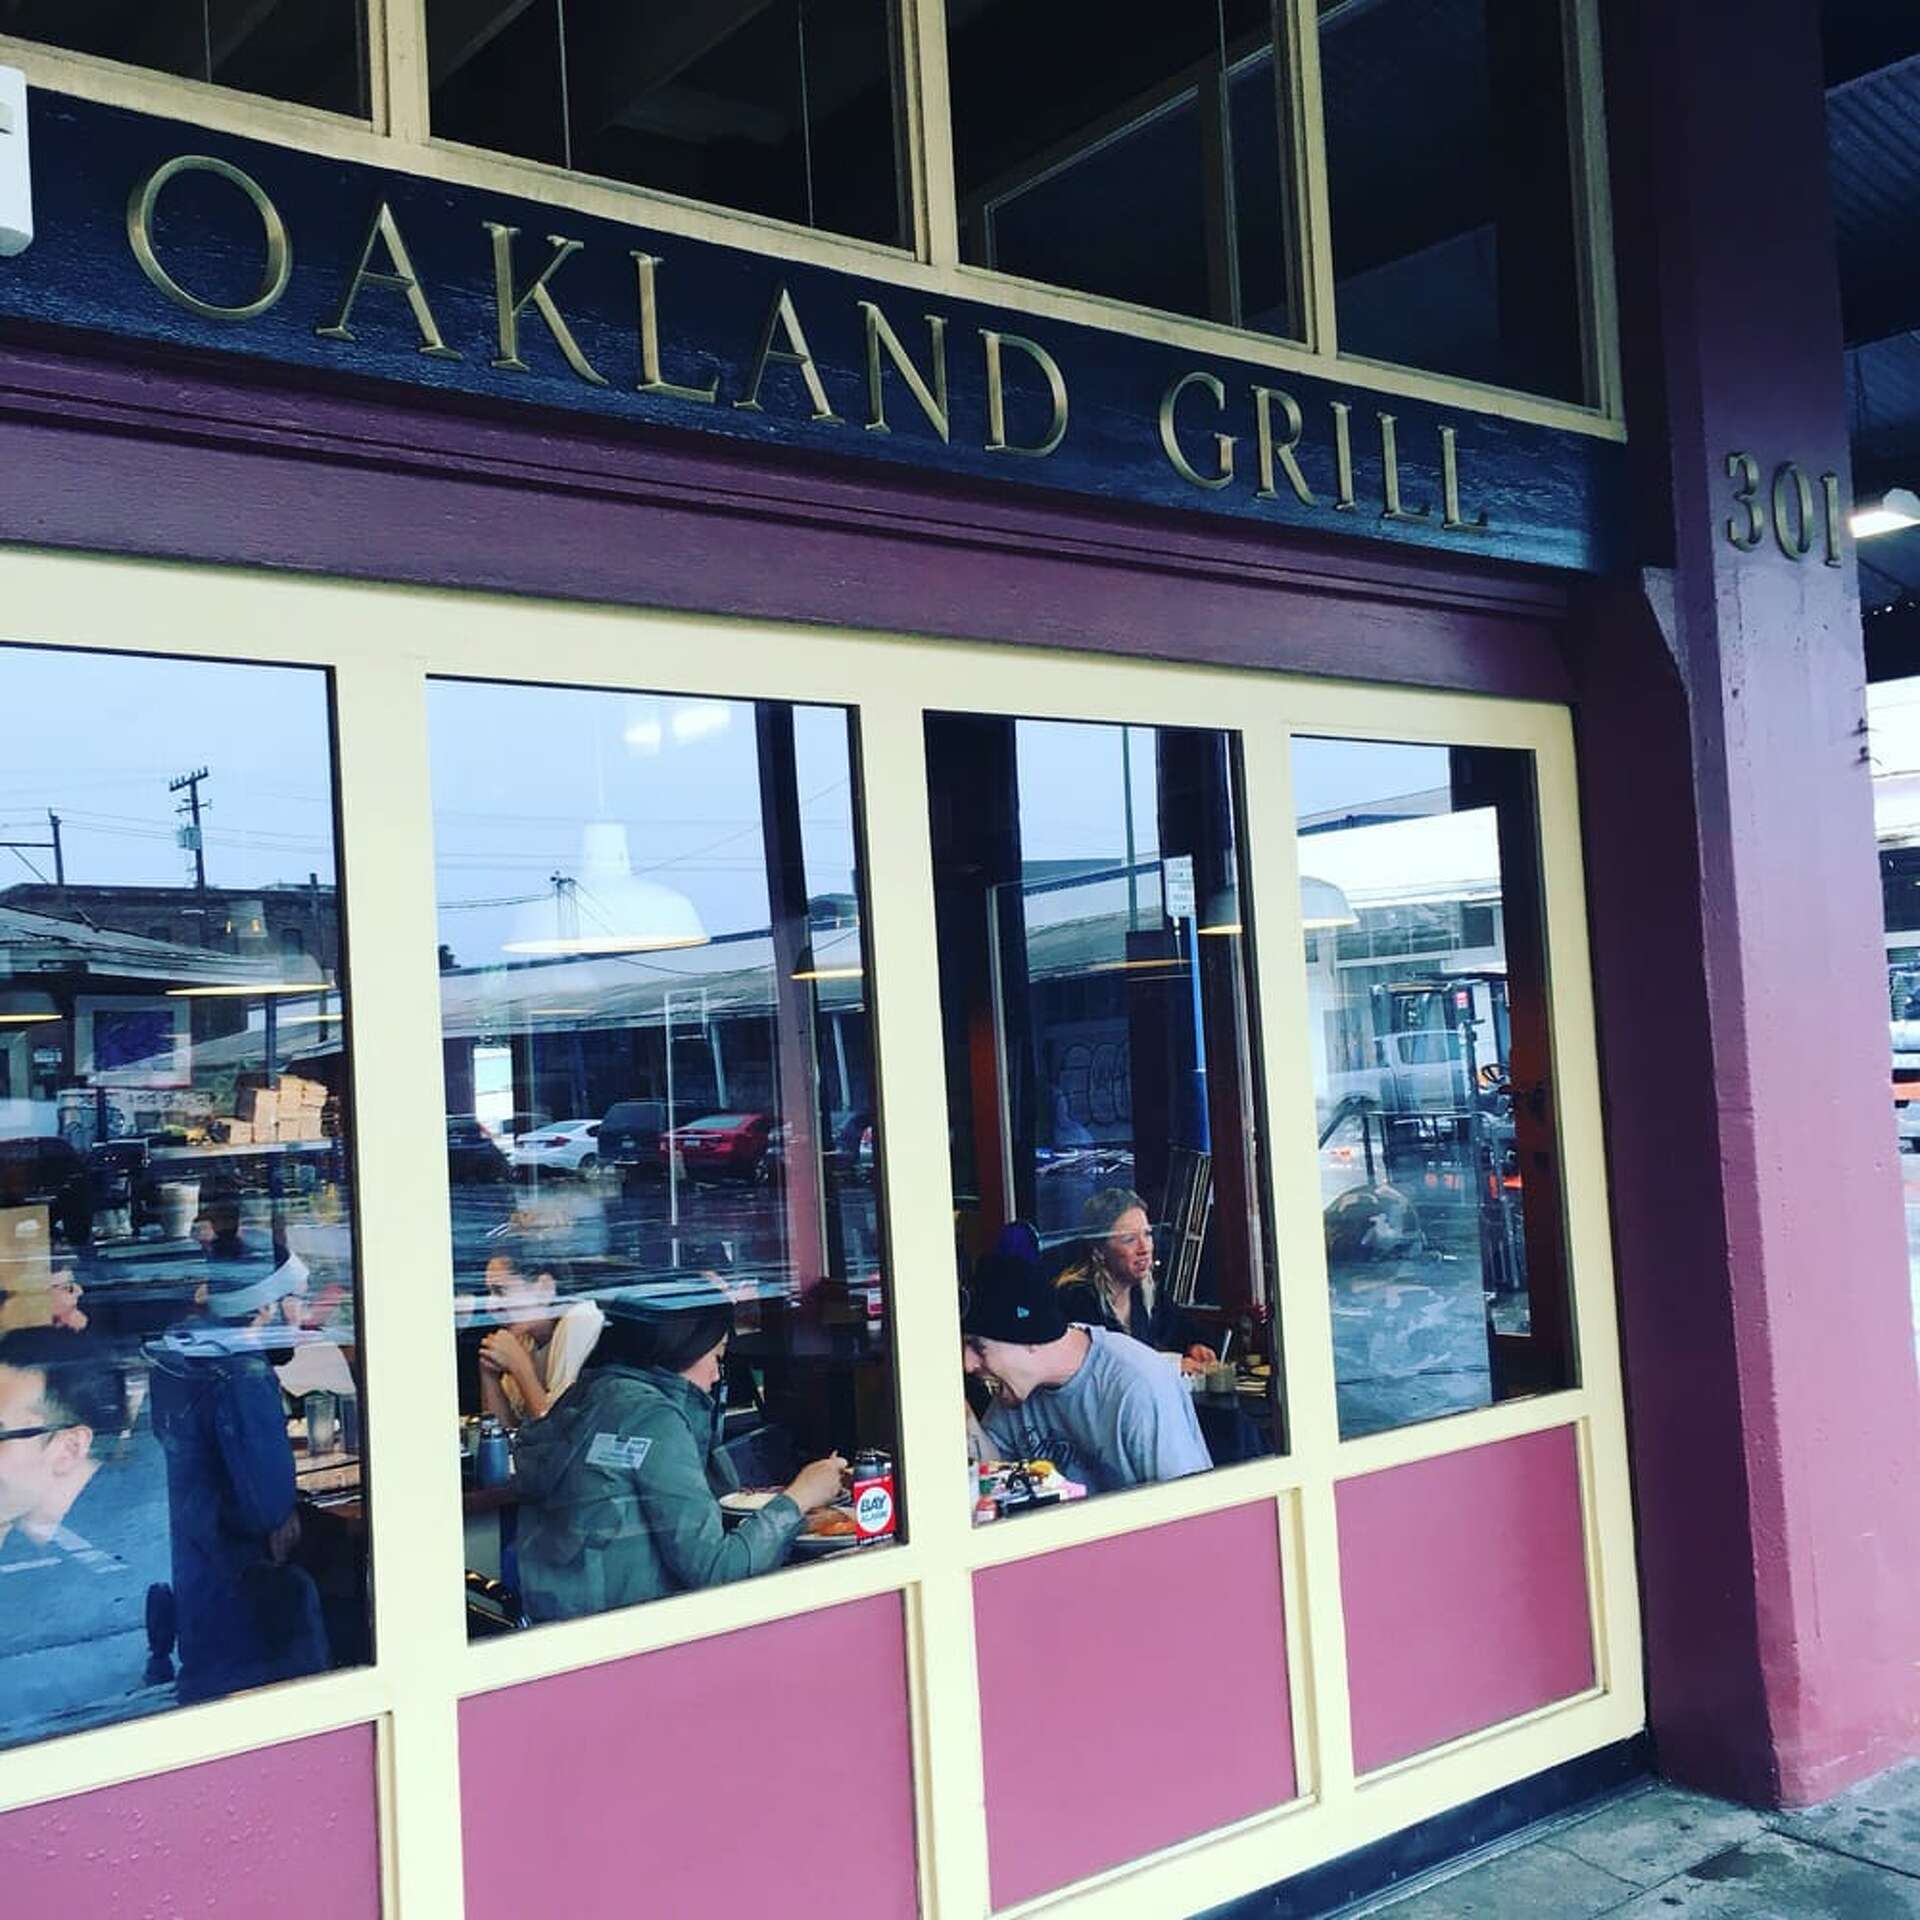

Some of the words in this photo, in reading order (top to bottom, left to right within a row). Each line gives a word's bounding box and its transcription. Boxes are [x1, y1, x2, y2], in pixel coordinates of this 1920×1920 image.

[127, 155, 1069, 458] OAKLAND
[1159, 371, 1488, 530] GRILL
[1725, 450, 1843, 569] 301
[861, 1496, 887, 1512] BAY
